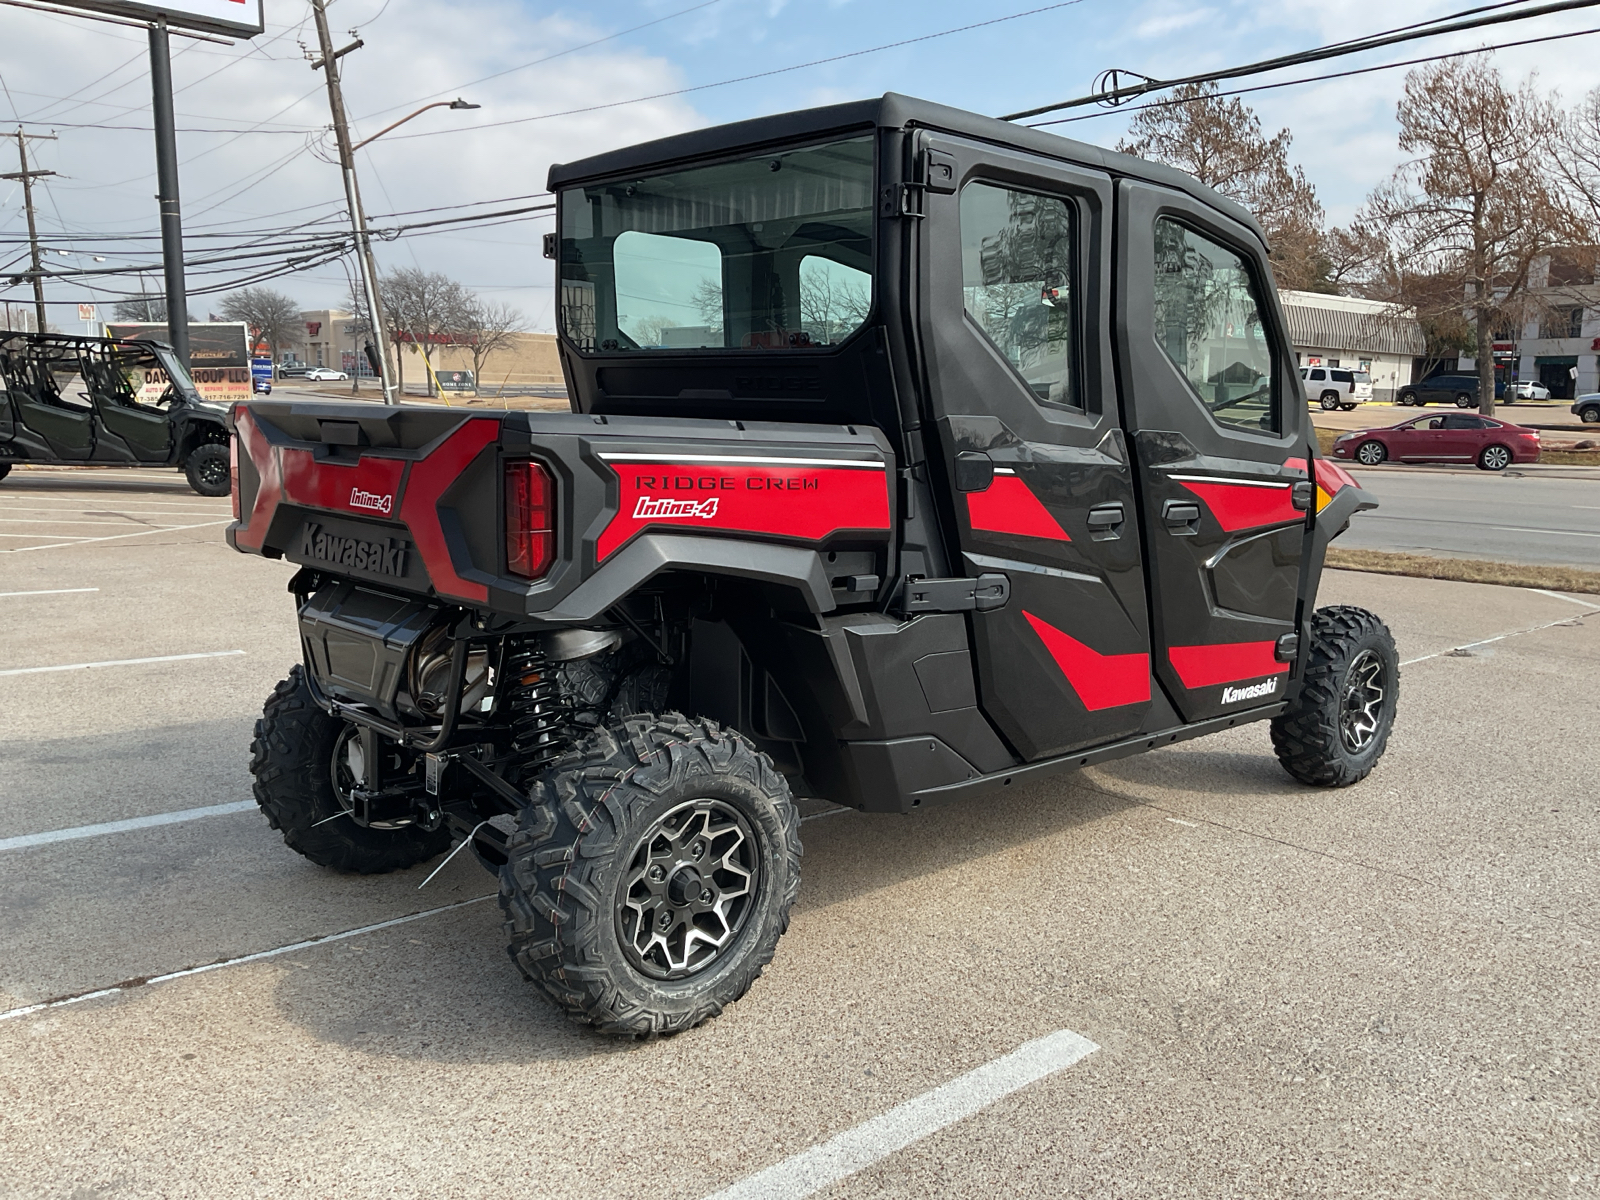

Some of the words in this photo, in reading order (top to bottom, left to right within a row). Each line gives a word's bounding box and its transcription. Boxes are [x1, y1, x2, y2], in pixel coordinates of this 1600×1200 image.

[228, 370, 248, 383] LLC
[636, 476, 735, 490] RIDGE
[746, 477, 819, 491] CREW
[350, 487, 393, 513] Inline-4
[633, 496, 719, 520] Inline-4
[300, 522, 411, 578] Kawasaki
[1221, 677, 1278, 704] Kawasaki
